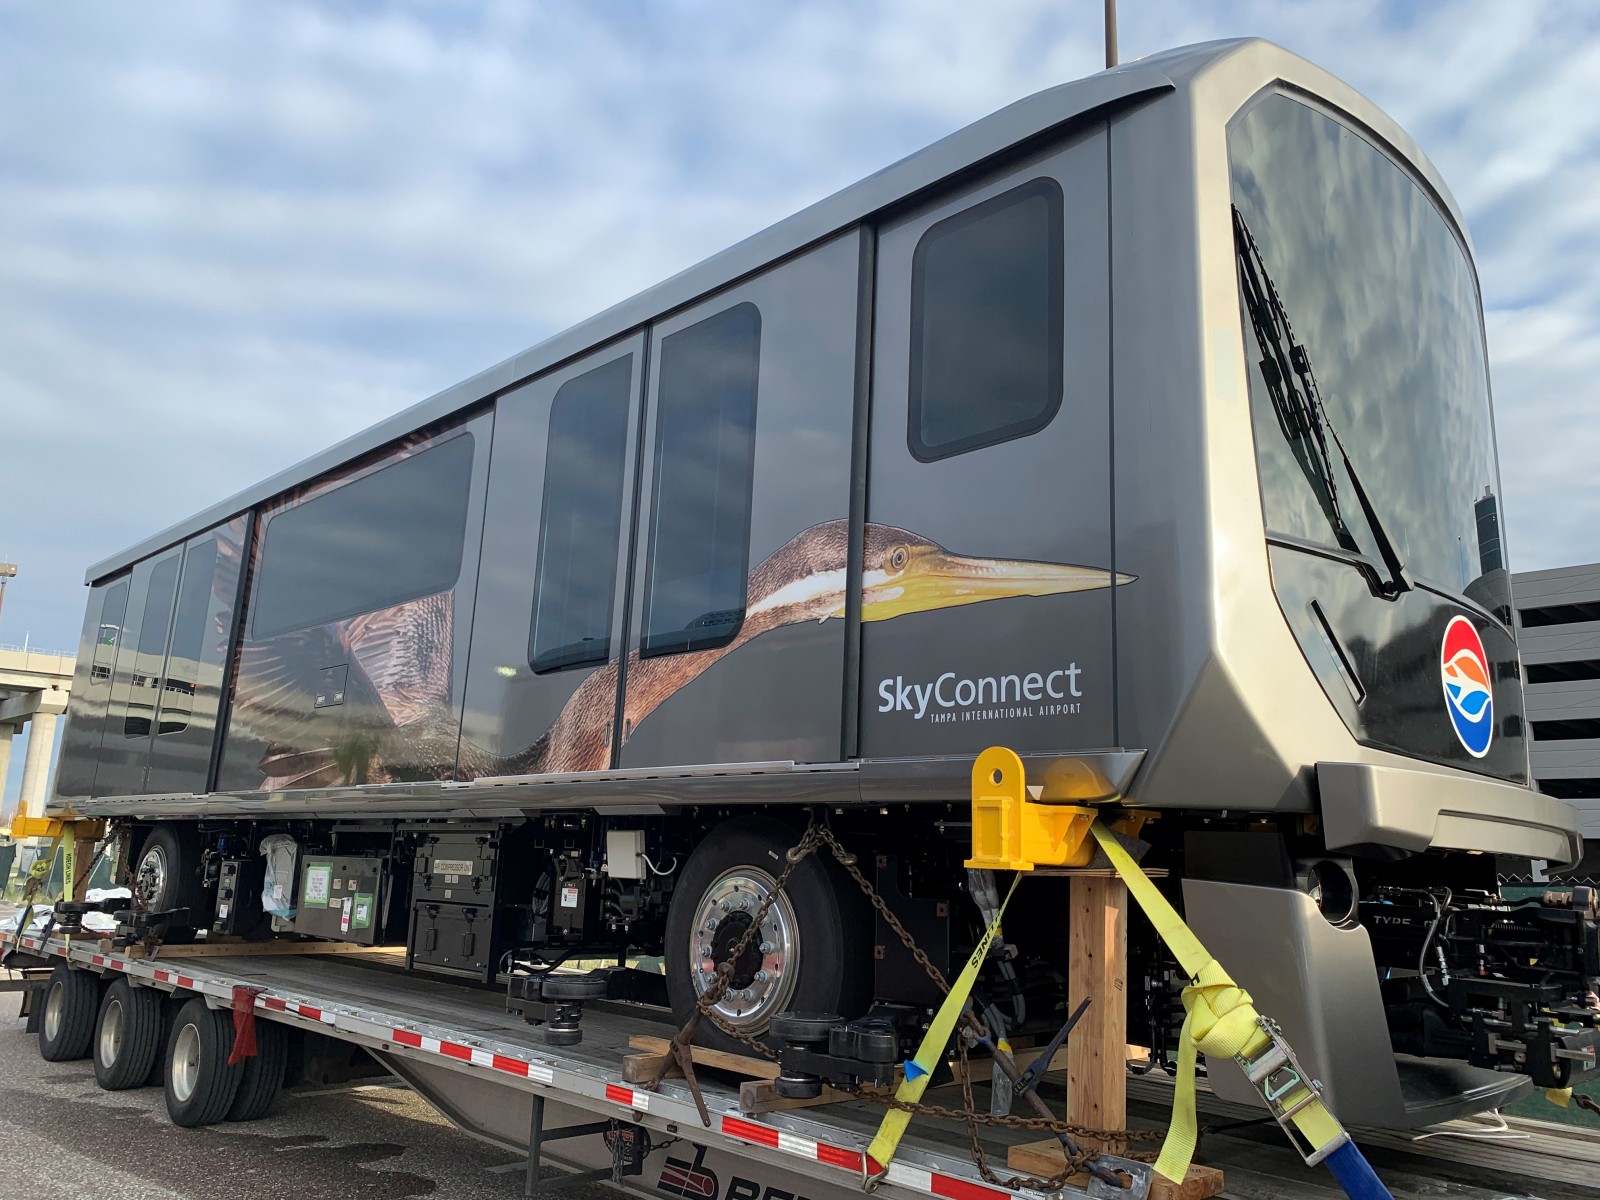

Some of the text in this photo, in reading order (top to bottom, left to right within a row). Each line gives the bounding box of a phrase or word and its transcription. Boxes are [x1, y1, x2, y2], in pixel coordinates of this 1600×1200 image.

[878, 661, 1082, 719] SkyConnect
[930, 703, 1081, 723] TAMPA INTERNATIONAL AIRPORT
